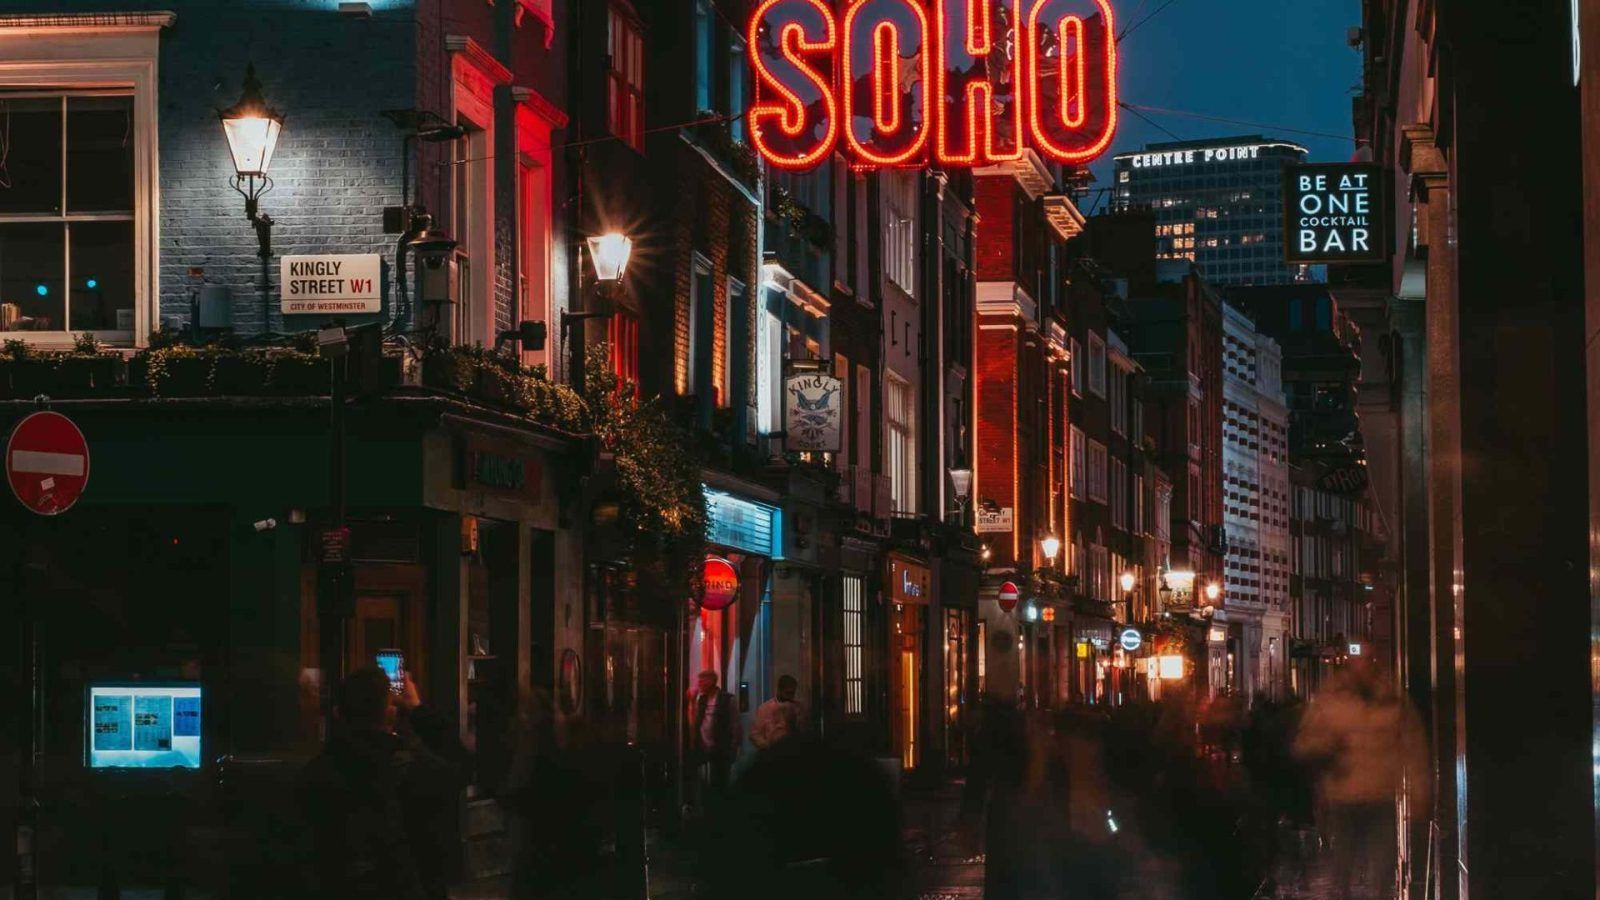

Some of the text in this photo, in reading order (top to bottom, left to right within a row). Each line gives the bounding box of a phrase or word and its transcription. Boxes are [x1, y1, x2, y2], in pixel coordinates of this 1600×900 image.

[748, 0, 1118, 167] SOHO
[1132, 145, 1260, 168] CENTRE POINT
[1299, 174, 1368, 191] BE AT
[1300, 193, 1369, 215] ONE
[1299, 216, 1369, 227] COCKTAIL
[1300, 229, 1369, 252] BAR
[290, 261, 341, 276] KINGLY
[290, 279, 372, 294] STREET W1
[290, 302, 366, 311] CITY OF WESTMINSTER
[788, 378, 838, 396] KINGLY
